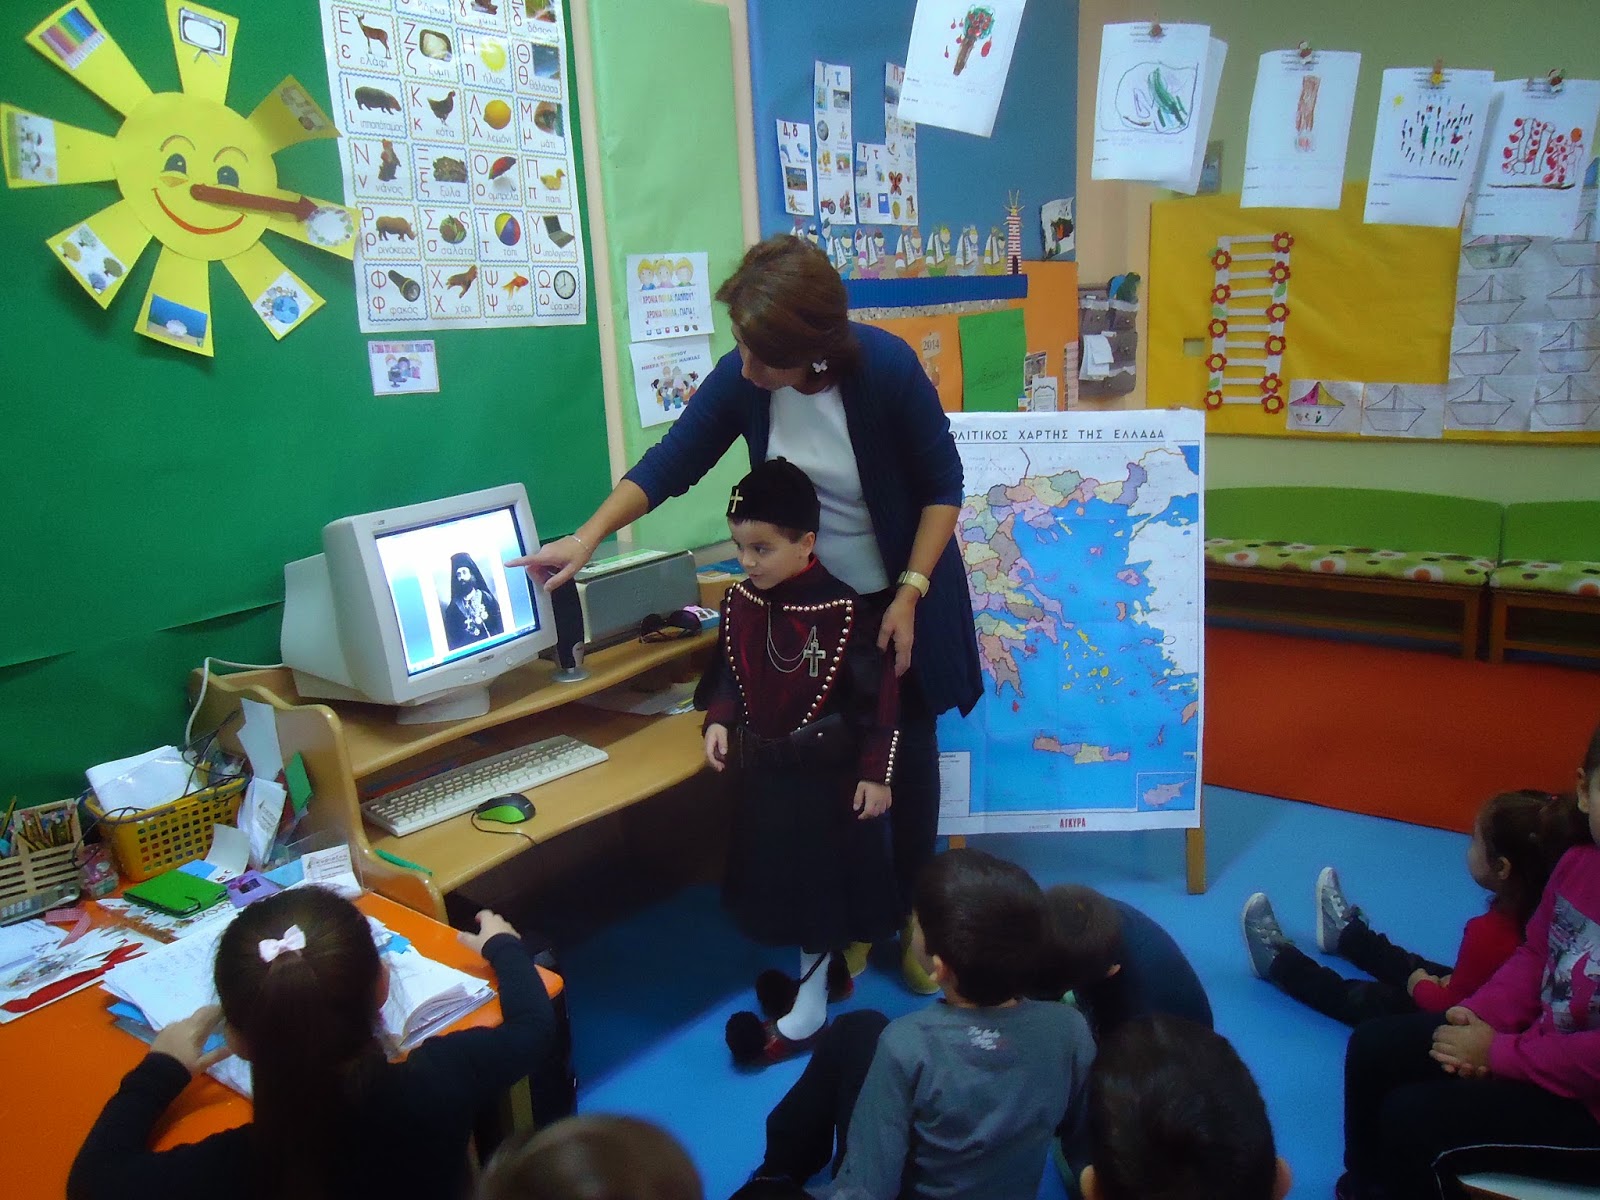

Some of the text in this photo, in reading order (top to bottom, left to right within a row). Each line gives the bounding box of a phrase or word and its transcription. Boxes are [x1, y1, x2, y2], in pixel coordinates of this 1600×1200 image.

[922, 339, 940, 351] 2014
[950, 429, 1164, 440] ΟΛΙΤΙΚΟΣ ΧΑΡΤΗΣ ΤΗΣ ΕΛΛΑΔΑ
